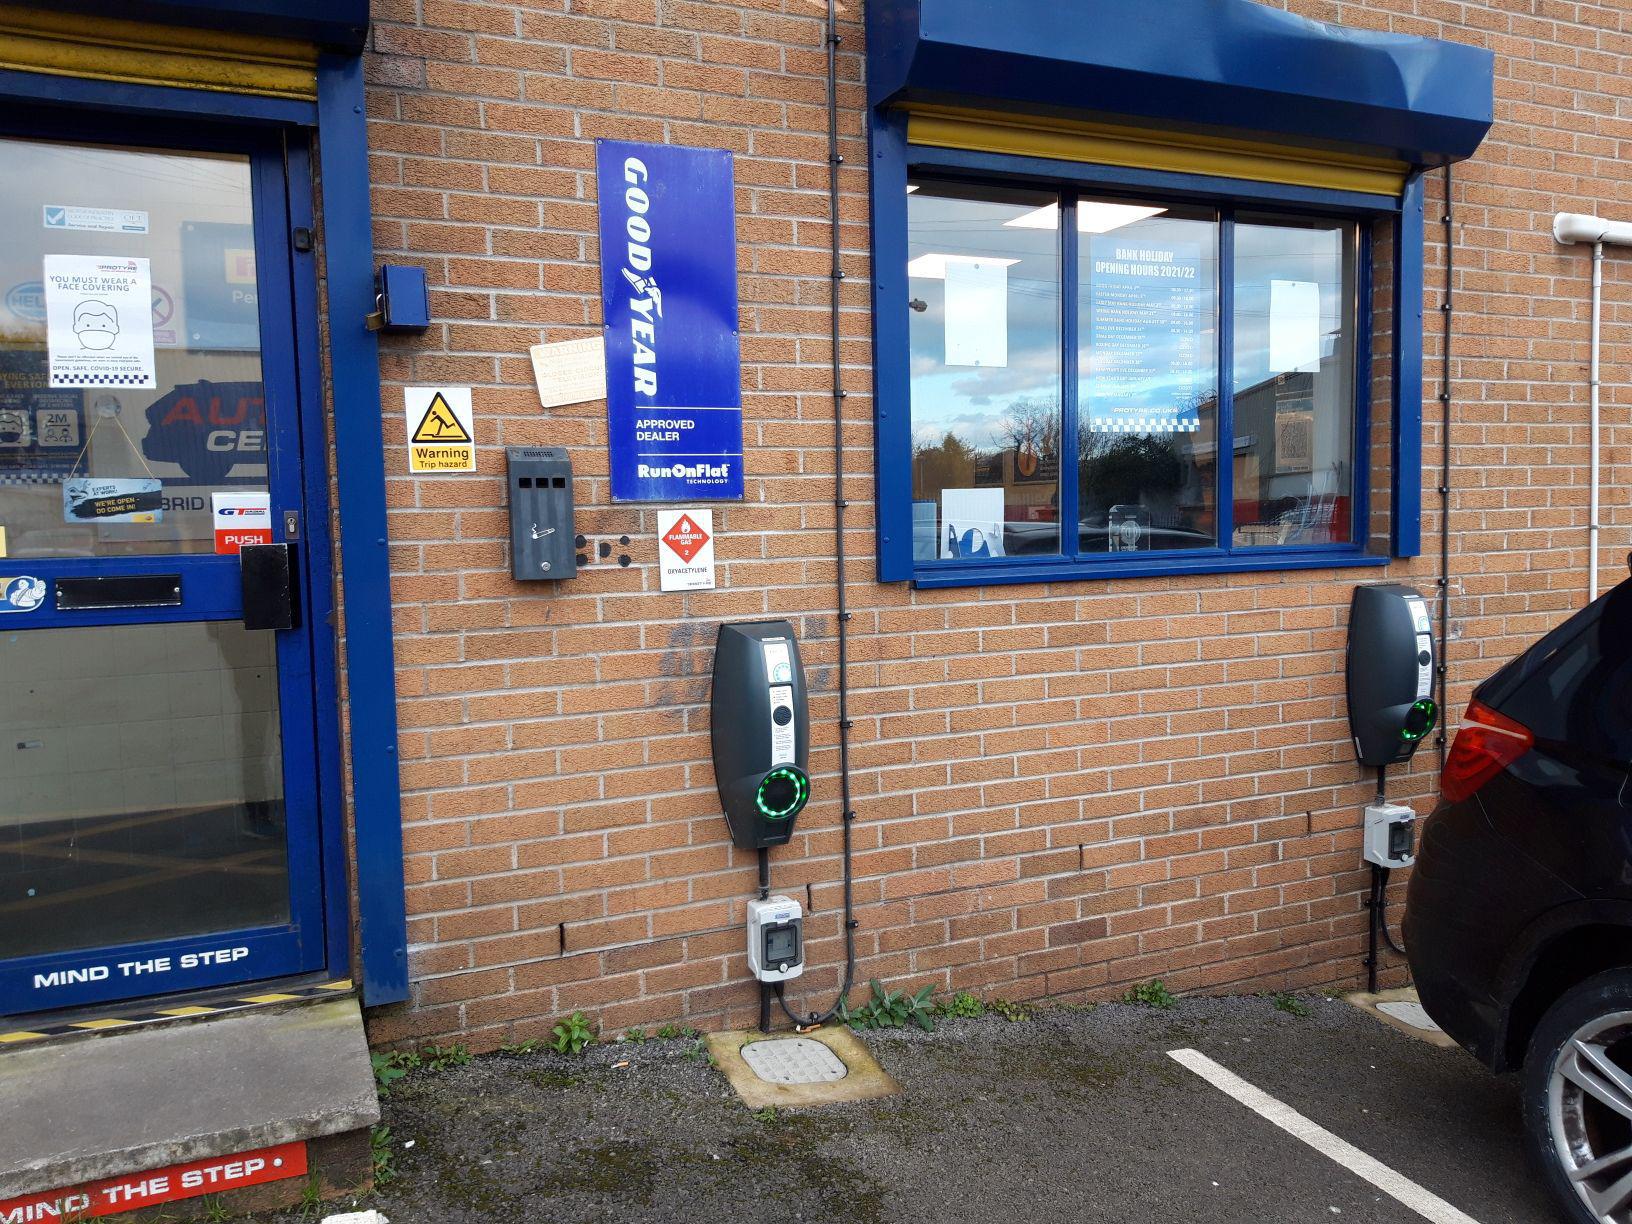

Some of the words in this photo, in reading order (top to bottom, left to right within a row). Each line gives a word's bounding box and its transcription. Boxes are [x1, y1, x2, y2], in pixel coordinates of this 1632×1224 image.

[1116, 248, 1139, 261] BANK
[1140, 249, 1174, 263] HOLIDAY
[1095, 261, 1130, 276] OPENING
[1130, 263, 1160, 278] HOURS
[1160, 265, 1195, 279] 2021/22
[50, 275, 69, 283] YOU
[72, 276, 98, 284] MUST
[624, 157, 658, 397] GOODYEAR
[58, 282, 80, 290] FACE
[82, 284, 130, 292] COVERING
[47, 414, 68, 423] 2M
[636, 420, 695, 430] APPROVED
[206, 430, 268, 452] CE
[636, 432, 680, 441] DEALER
[416, 448, 468, 460] Warning
[420, 461, 436, 469] Trip
[638, 464, 730, 478] RunOnFlat
[118, 497, 135, 505] OPEN
[107, 504, 126, 513] COME
[224, 536, 264, 544] PUSH
[668, 566, 708, 575] OXYACETYLENE
[34, 966, 109, 988] MIND
[118, 958, 172, 978] THE
[180, 947, 249, 969] STEP
[0, 1193, 90, 1224] MIND
[102, 1176, 170, 1206] THE
[182, 1158, 265, 1188] STEP
